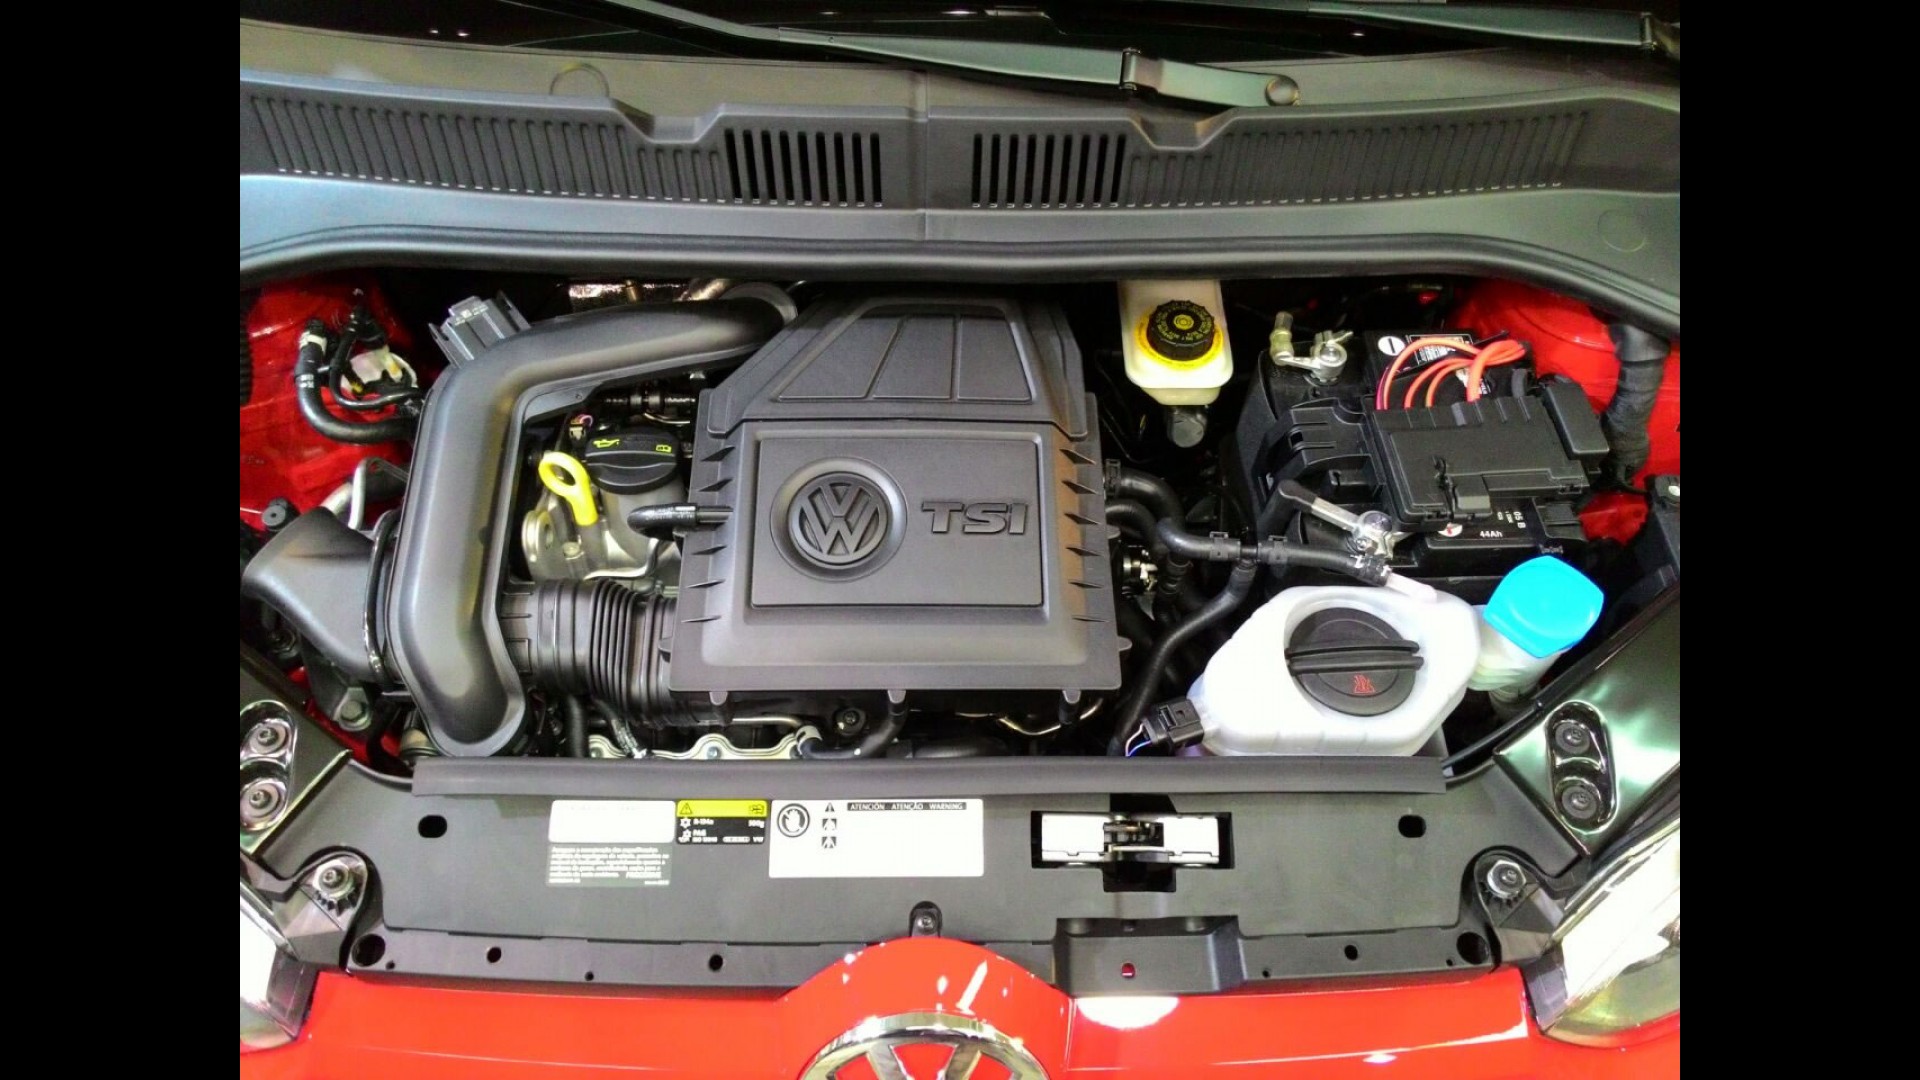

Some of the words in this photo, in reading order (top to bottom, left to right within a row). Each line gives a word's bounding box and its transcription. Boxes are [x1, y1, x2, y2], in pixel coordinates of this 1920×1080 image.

[921, 501, 1028, 535] TSI
[1480, 530, 1504, 538] 44Ah
[929, 802, 963, 810] WARNING
